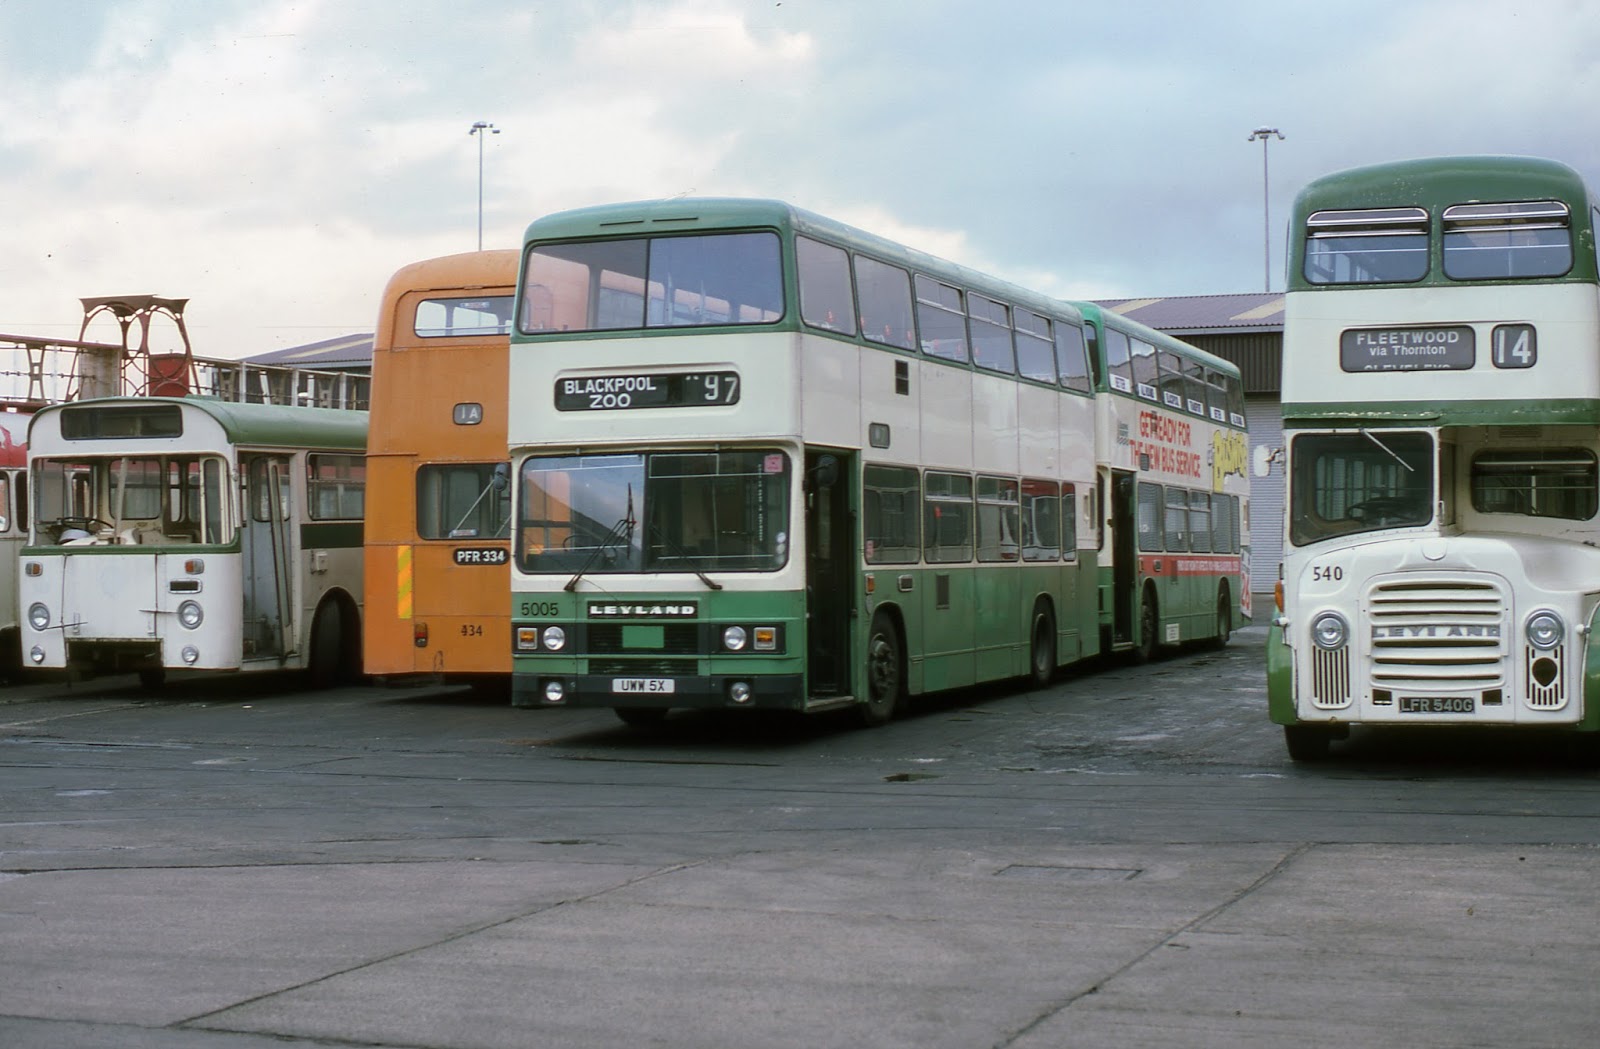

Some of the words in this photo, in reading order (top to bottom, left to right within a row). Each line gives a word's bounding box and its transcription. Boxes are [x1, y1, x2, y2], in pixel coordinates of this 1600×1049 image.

[1356, 331, 1459, 345] FLEETWOOD
[1369, 346, 1387, 356] via
[1392, 345, 1446, 356] Thornton
[1497, 329, 1532, 364] 14
[564, 376, 656, 394] BLACKPOOL
[704, 375, 738, 402] 97
[589, 393, 631, 408] ZOO
[1177, 421, 1191, 447] FOR
[1161, 446, 1174, 473] BUS
[1176, 450, 1201, 478] SERVICE
[457, 550, 481, 562] PFR
[482, 550, 505, 562] 334
[1313, 566, 1343, 581] 540
[521, 602, 559, 616] 5005
[590, 605, 695, 615] LEYLAND
[1371, 625, 1500, 637] LEYLAND
[621, 680, 645, 691] UWW
[650, 680, 665, 691] 5X
[1401, 699, 1430, 711] LFR
[1433, 699, 1473, 712] 540G
